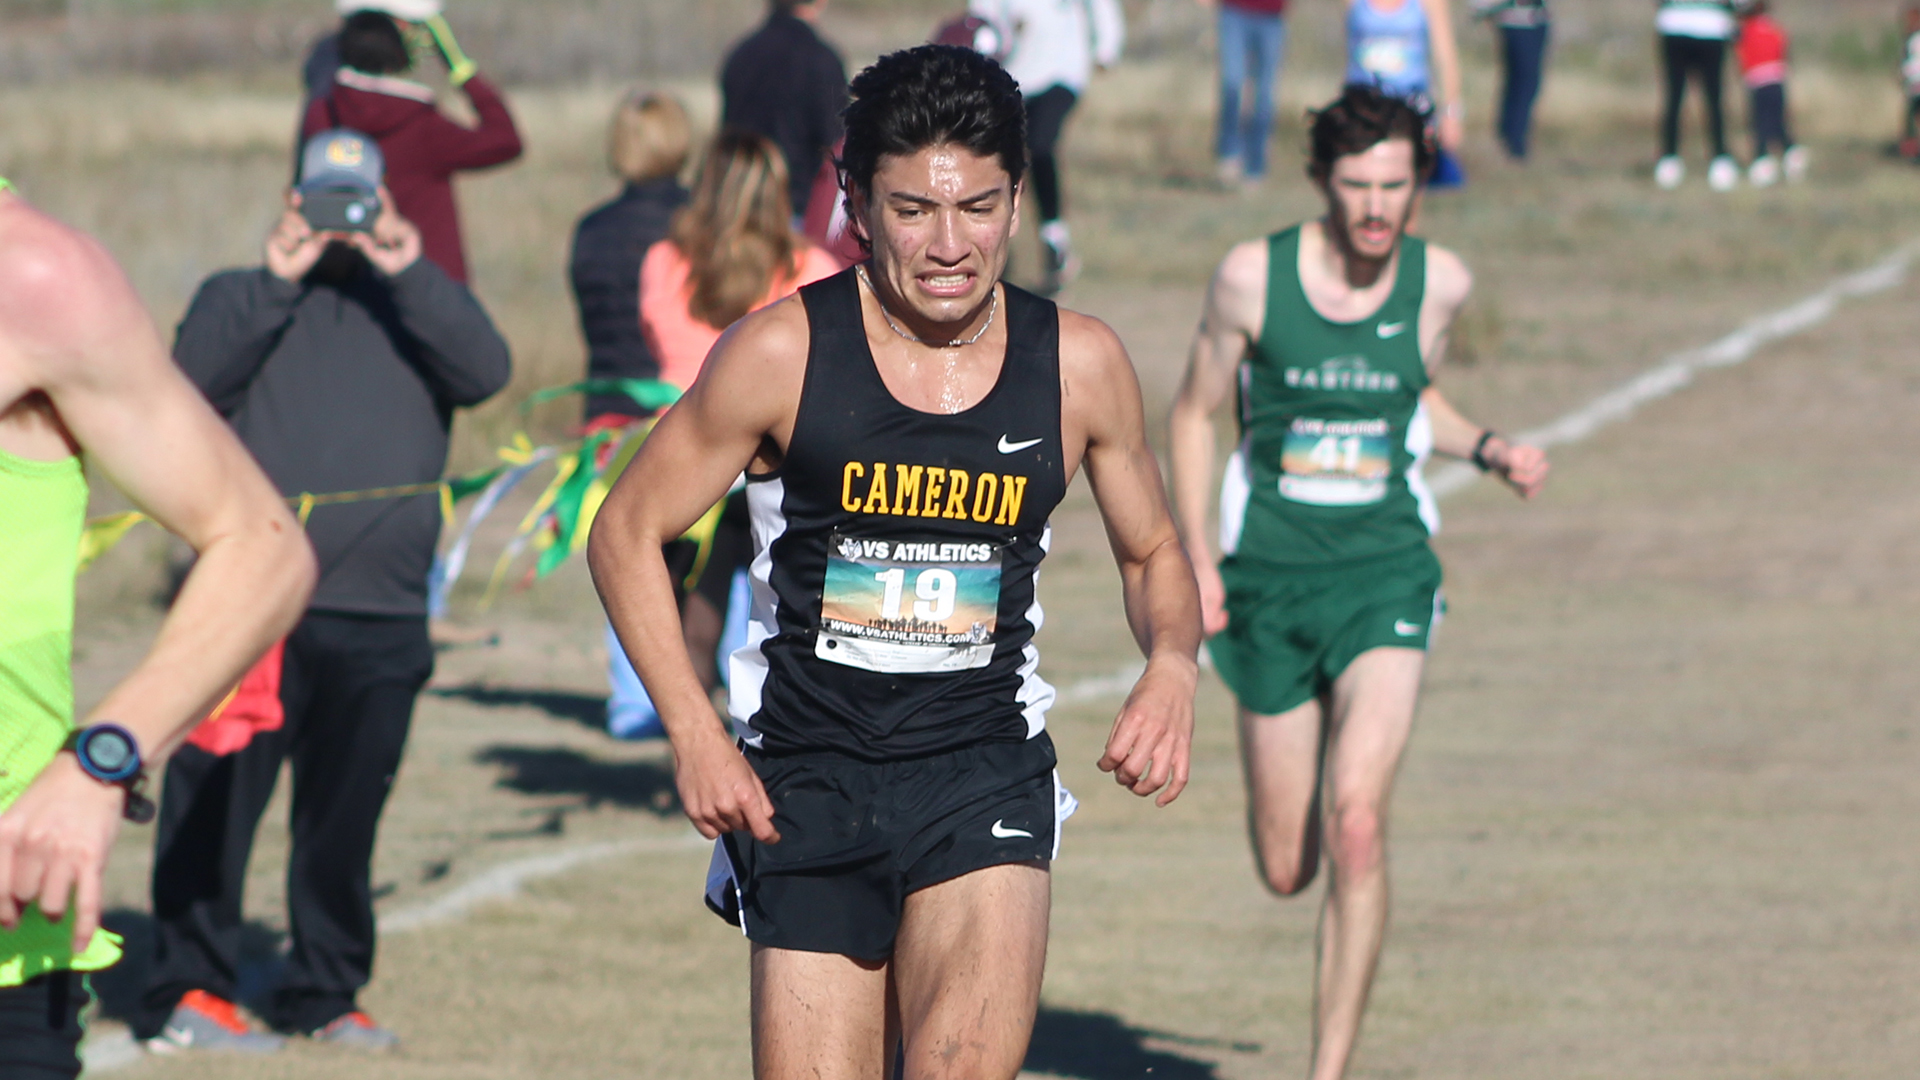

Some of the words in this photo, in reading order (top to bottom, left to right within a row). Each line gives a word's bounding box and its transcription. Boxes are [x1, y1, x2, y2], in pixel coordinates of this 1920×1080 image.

[1309, 437, 1361, 471] 41
[841, 461, 1027, 526] CAMERON
[862, 540, 890, 560] VS
[892, 542, 992, 562] ATHLETICS
[874, 568, 957, 622] 19
